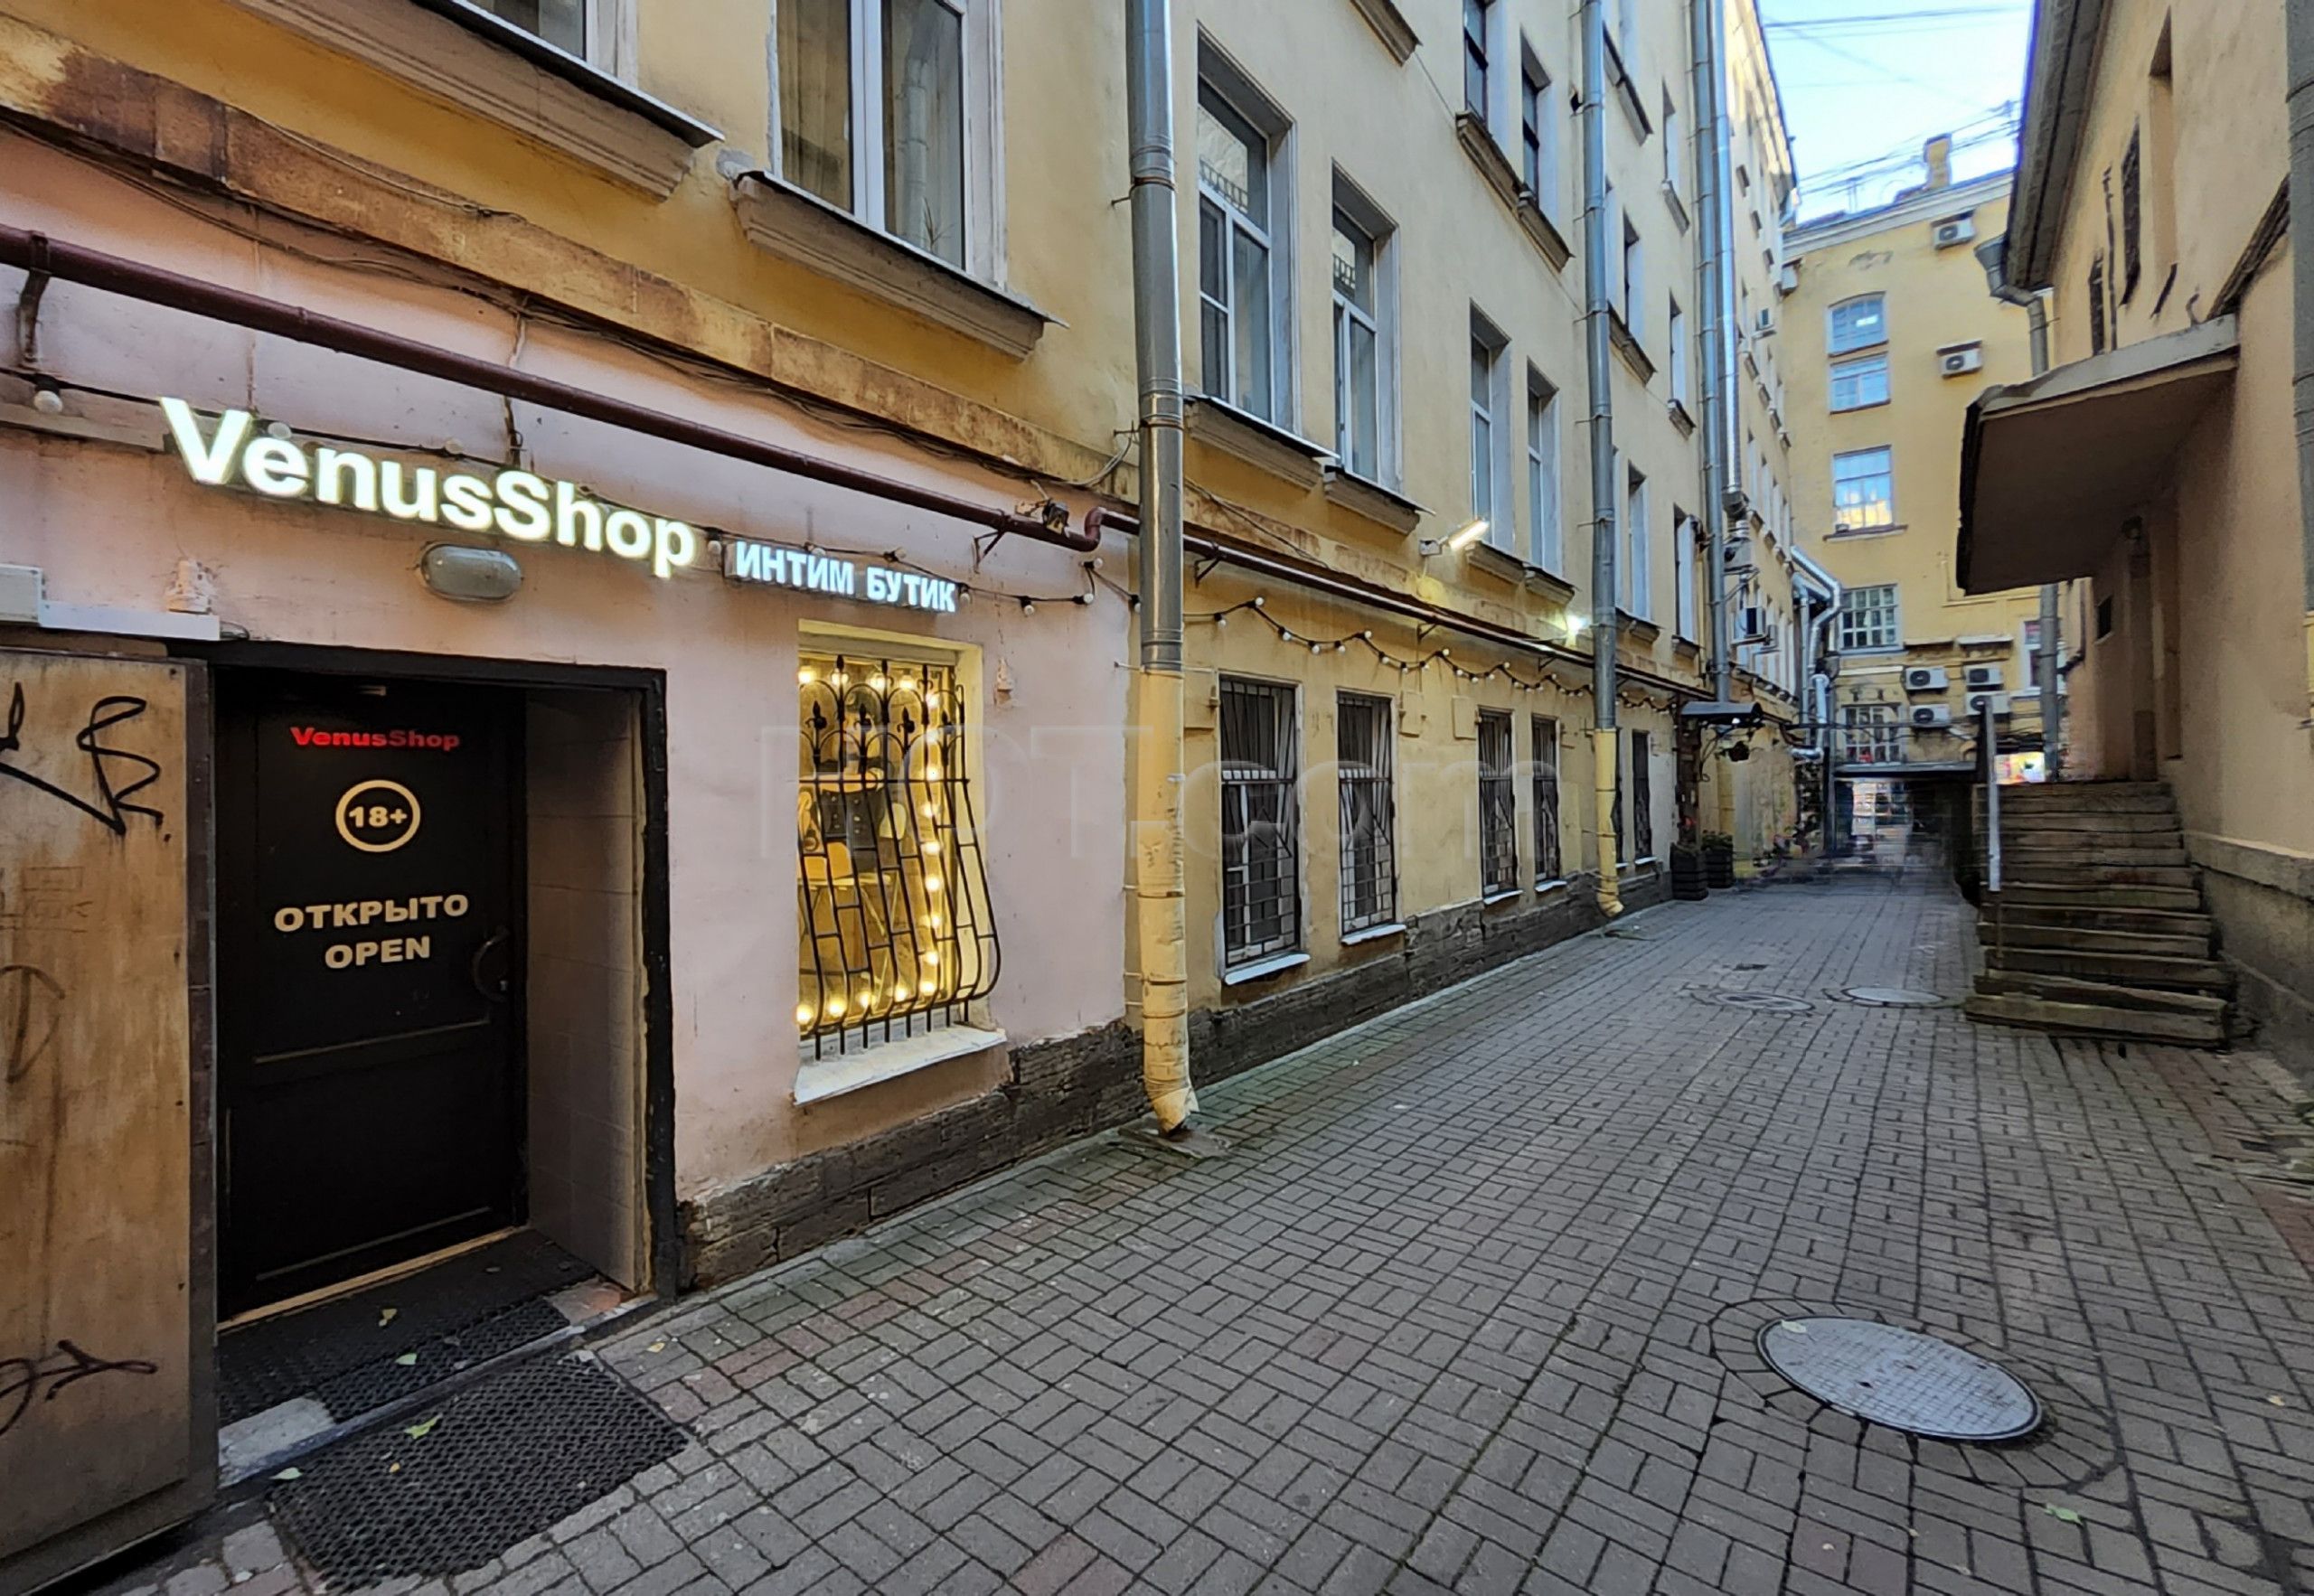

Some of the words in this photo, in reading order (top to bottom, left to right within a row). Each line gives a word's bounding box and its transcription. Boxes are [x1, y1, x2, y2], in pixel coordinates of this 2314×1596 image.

[158, 396, 697, 578] VenusShop
[736, 540, 854, 596] ИНТИМ
[866, 566, 956, 613] БУТИК
[290, 726, 460, 751] VenusShop
[349, 806, 408, 828] 18+
[274, 894, 469, 932] ОТКРЫТО
[325, 935, 430, 969] OPEN
